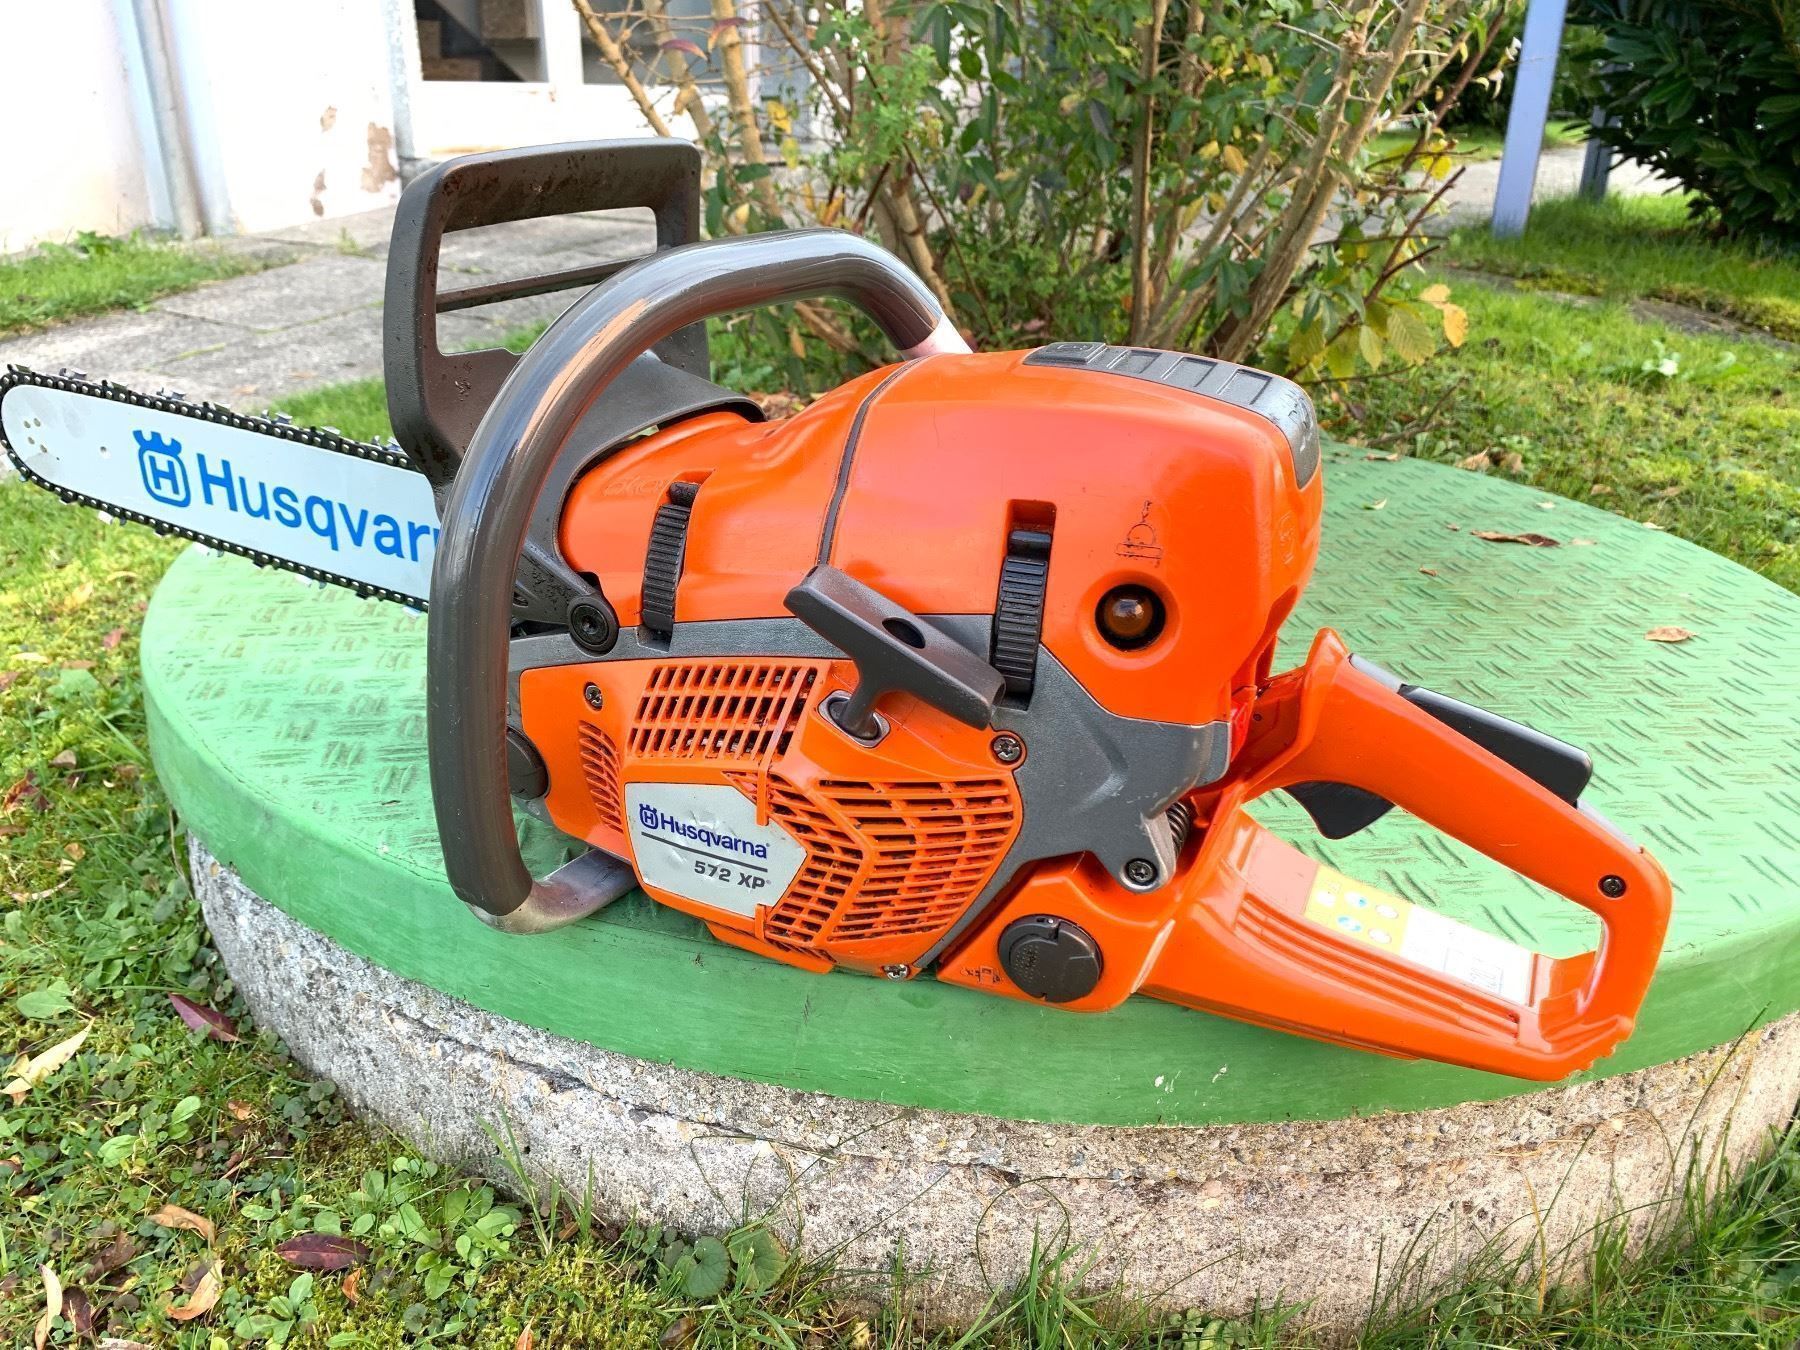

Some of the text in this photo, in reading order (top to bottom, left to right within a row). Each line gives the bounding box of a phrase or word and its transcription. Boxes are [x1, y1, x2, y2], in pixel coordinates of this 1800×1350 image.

[196, 453, 441, 562] Husqvar
[660, 813, 768, 859] Husqvarna
[694, 860, 766, 890] 572 XP
